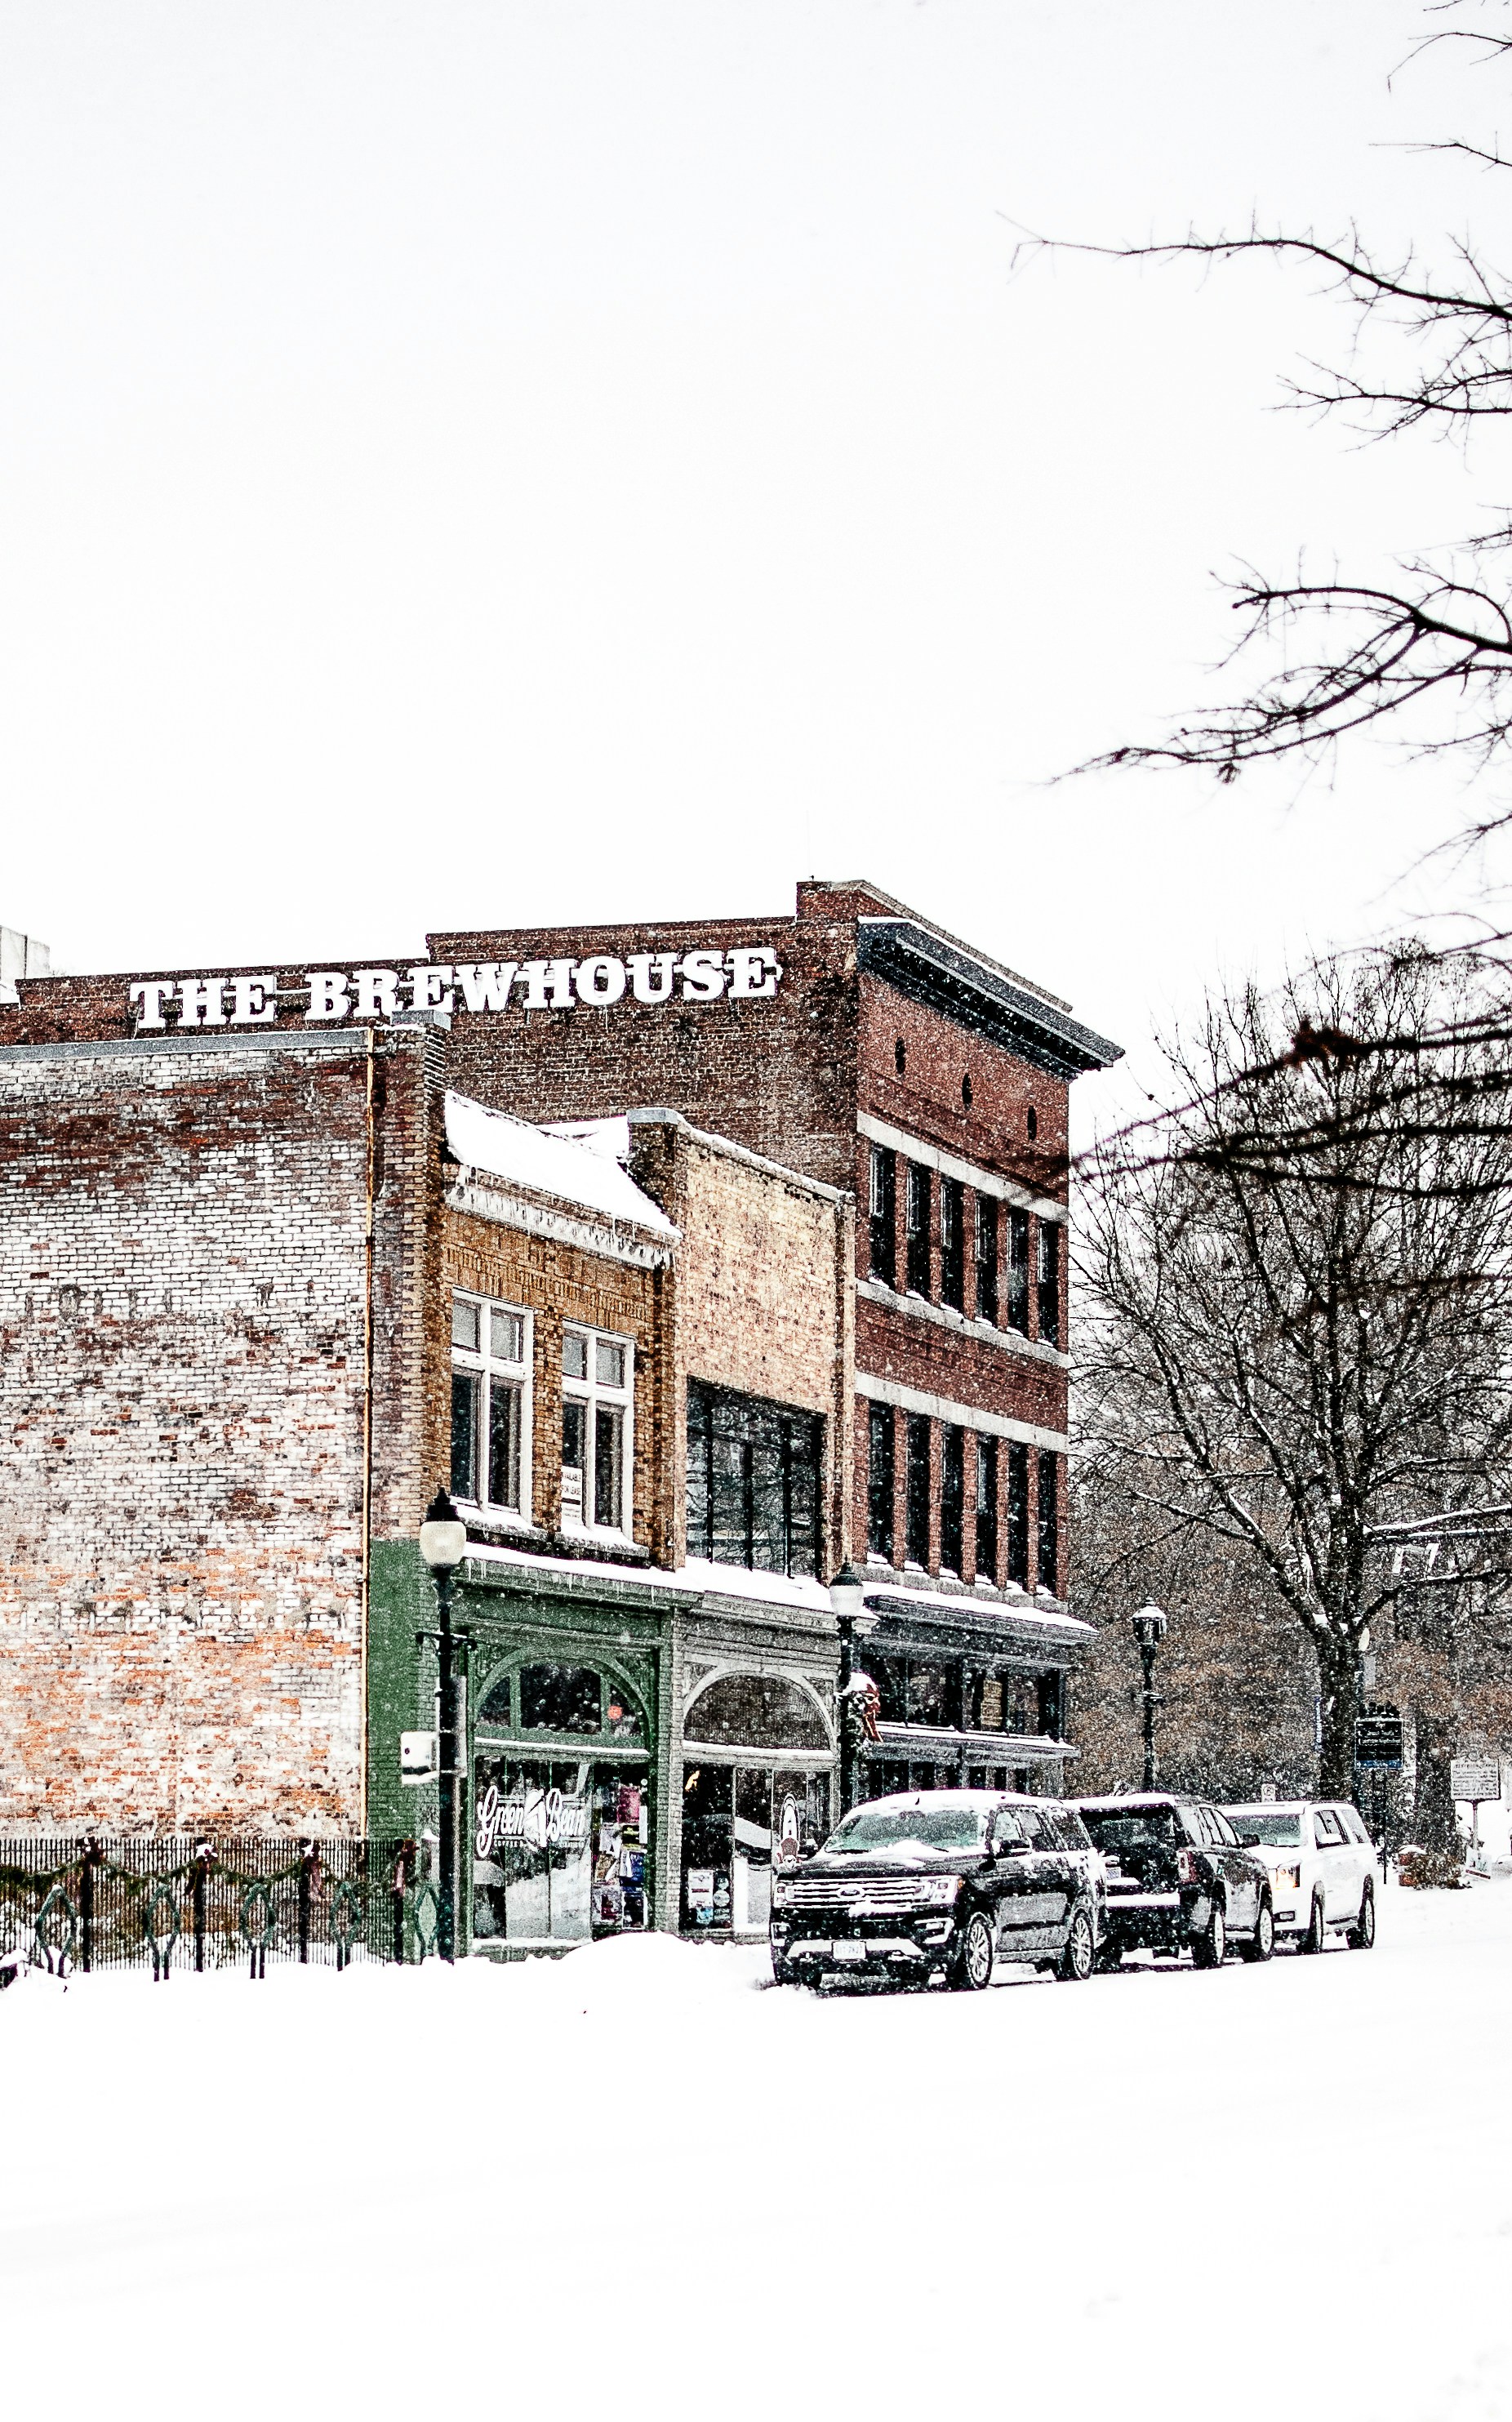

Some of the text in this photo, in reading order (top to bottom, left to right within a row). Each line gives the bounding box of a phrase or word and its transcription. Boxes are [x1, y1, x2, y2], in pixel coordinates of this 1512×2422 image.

[130, 947, 778, 1028] THE BREWHOUSE
[476, 1785, 585, 1858] Green Bean
